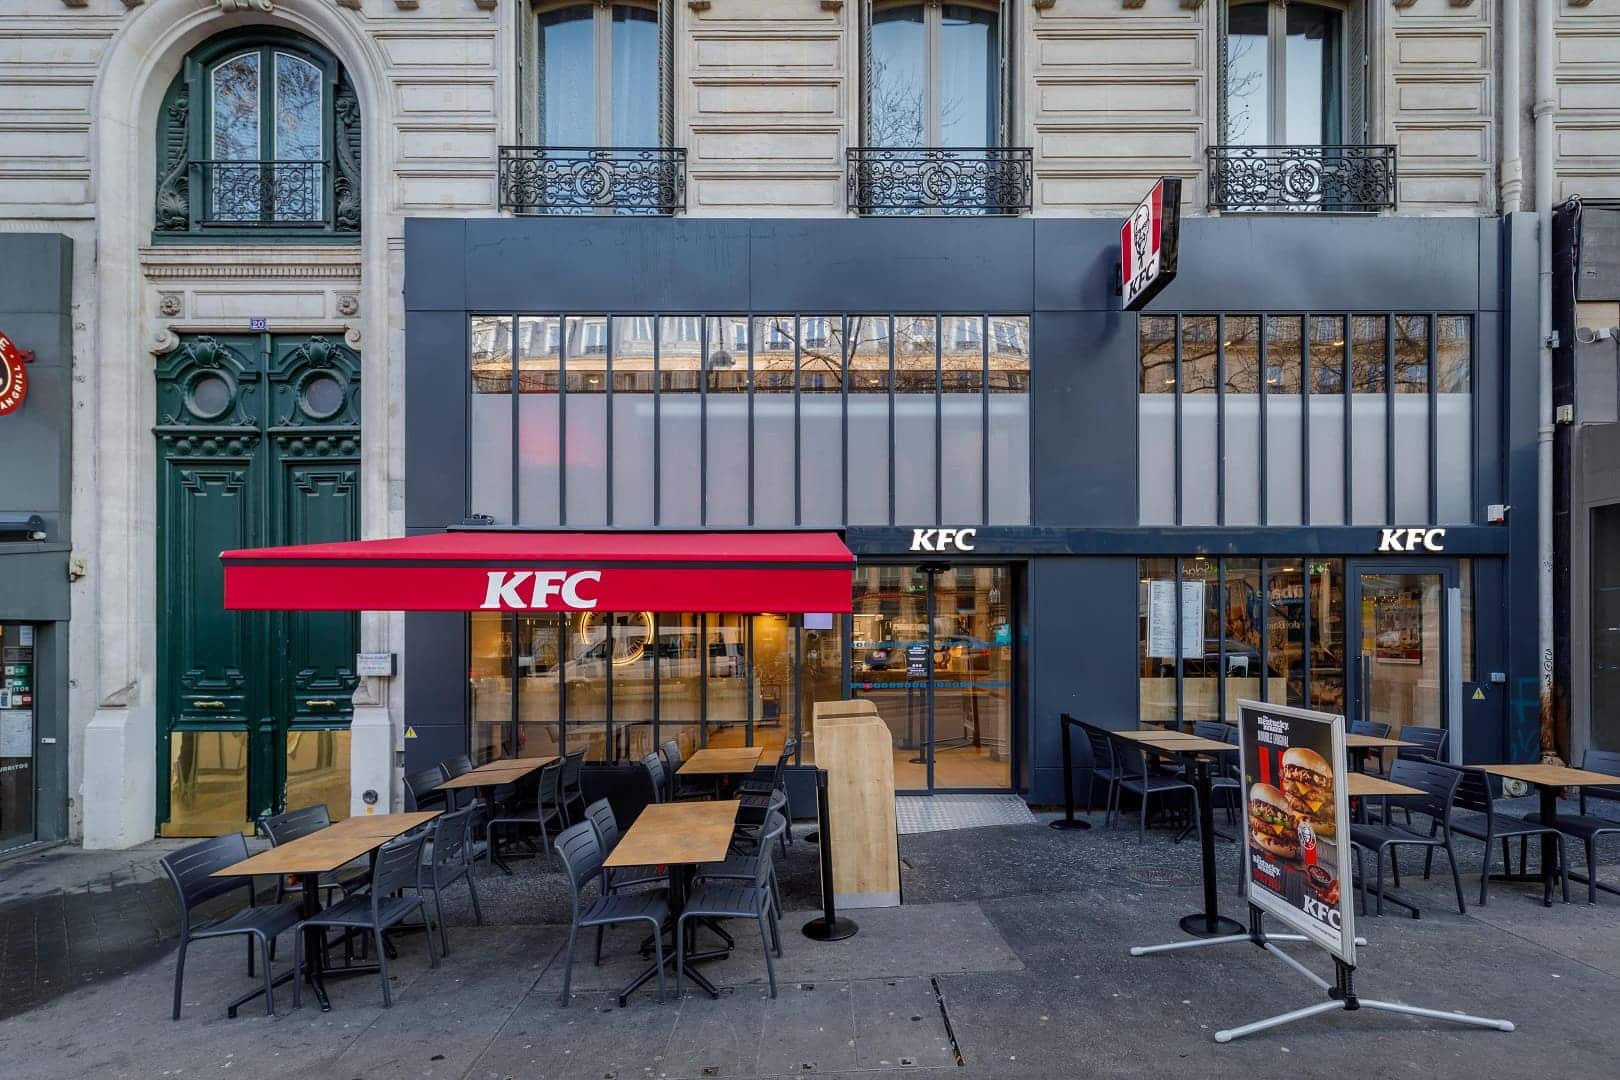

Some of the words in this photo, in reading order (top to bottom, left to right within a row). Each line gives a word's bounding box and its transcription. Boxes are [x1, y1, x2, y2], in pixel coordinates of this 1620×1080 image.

[1128, 259, 1155, 302] KFC
[908, 528, 977, 551] KFC
[1378, 528, 1446, 551] KFC
[479, 570, 602, 609] KFC
[1303, 894, 1341, 930] KFC
